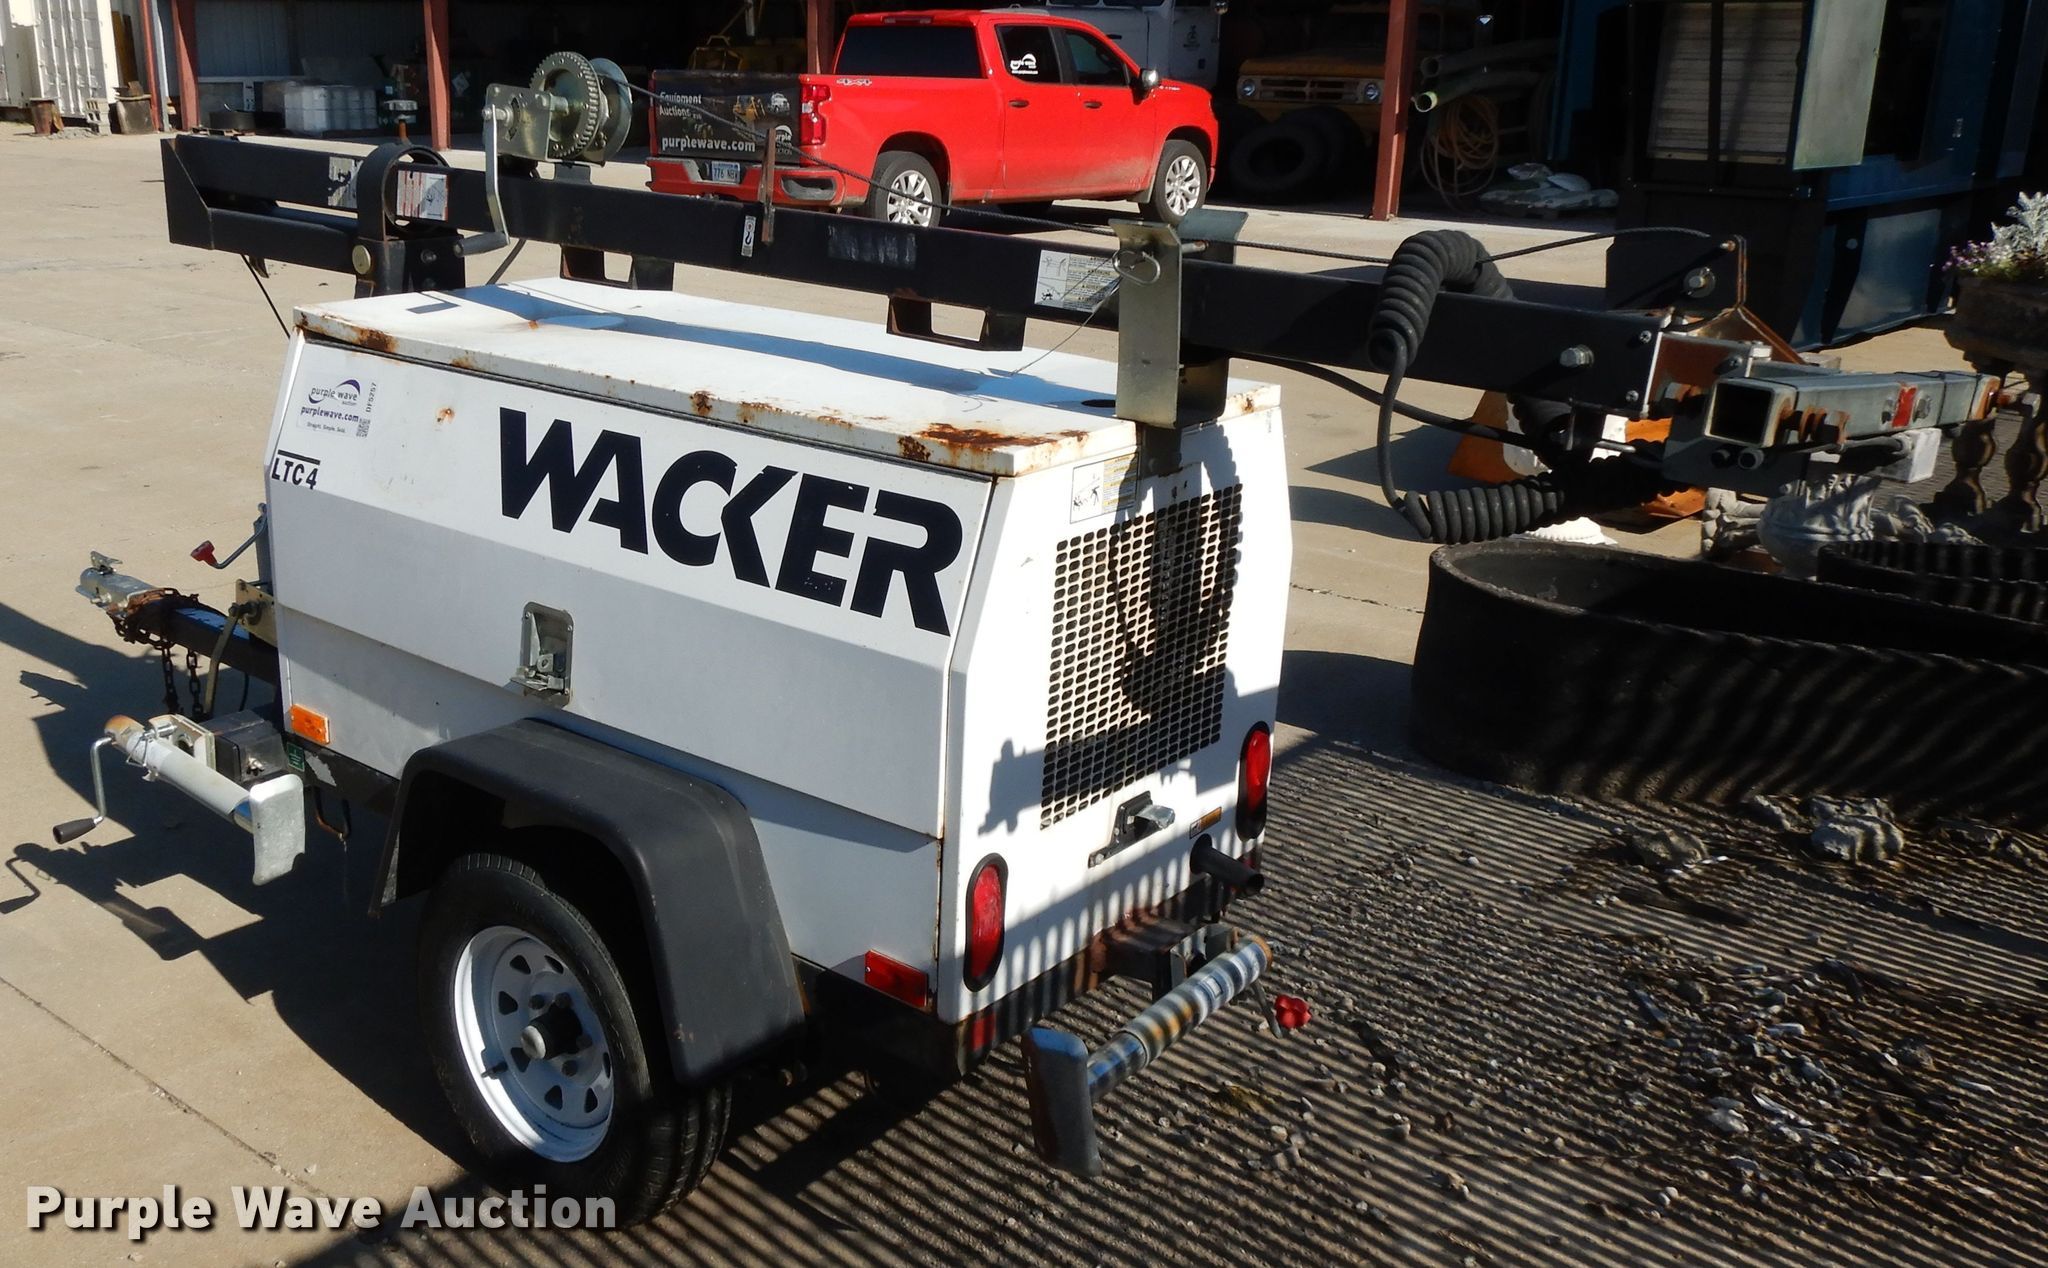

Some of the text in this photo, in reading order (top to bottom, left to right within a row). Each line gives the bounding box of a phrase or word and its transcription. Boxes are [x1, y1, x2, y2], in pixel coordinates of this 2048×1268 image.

[662, 135, 756, 152] purplewave.com
[311, 387, 358, 401] purple wave
[300, 406, 359, 423] purplewave.com
[500, 406, 963, 637] WACKER
